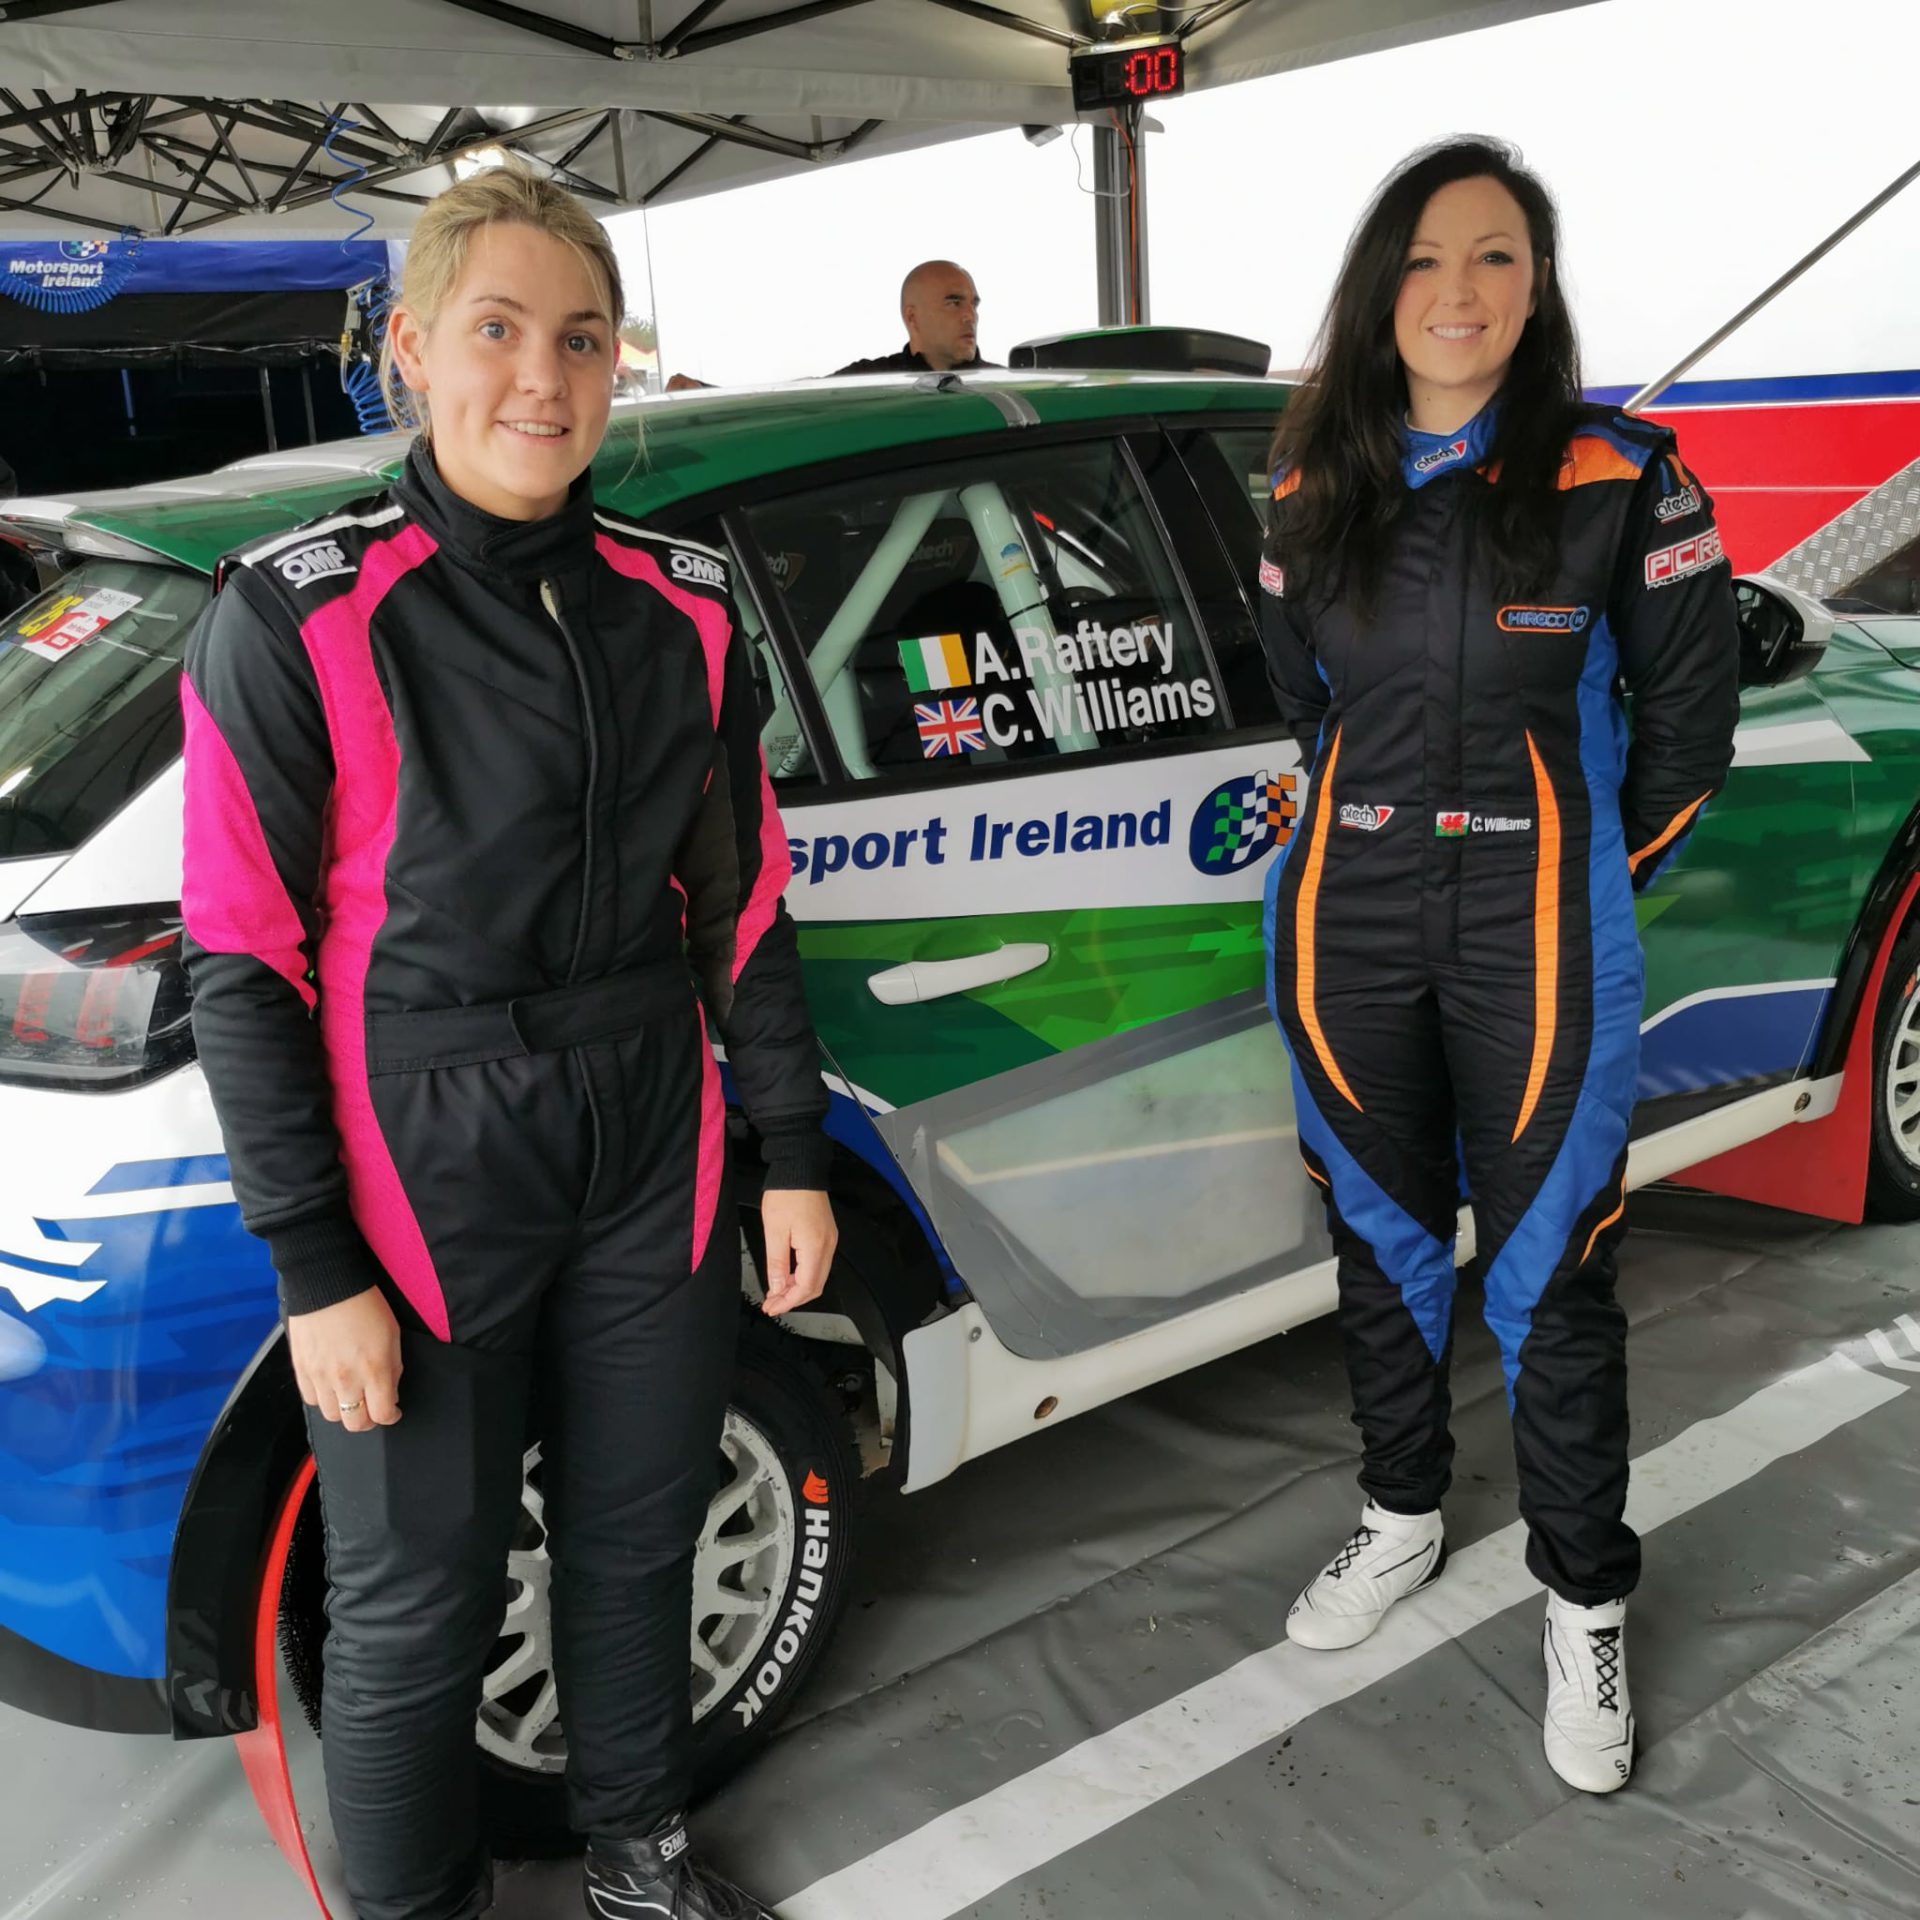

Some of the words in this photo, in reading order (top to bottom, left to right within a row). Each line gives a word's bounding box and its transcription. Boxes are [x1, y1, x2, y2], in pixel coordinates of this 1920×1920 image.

[9, 260, 104, 275] Motorsport
[281, 545, 346, 582] OMP
[670, 553, 726, 584] OMP
[975, 620, 1173, 684] A.Raftery
[982, 678, 1216, 747] C.Williams
[970, 799, 1172, 862] Ireland
[1340, 804, 1376, 825] atech
[660, 1830, 687, 1857] OMP
